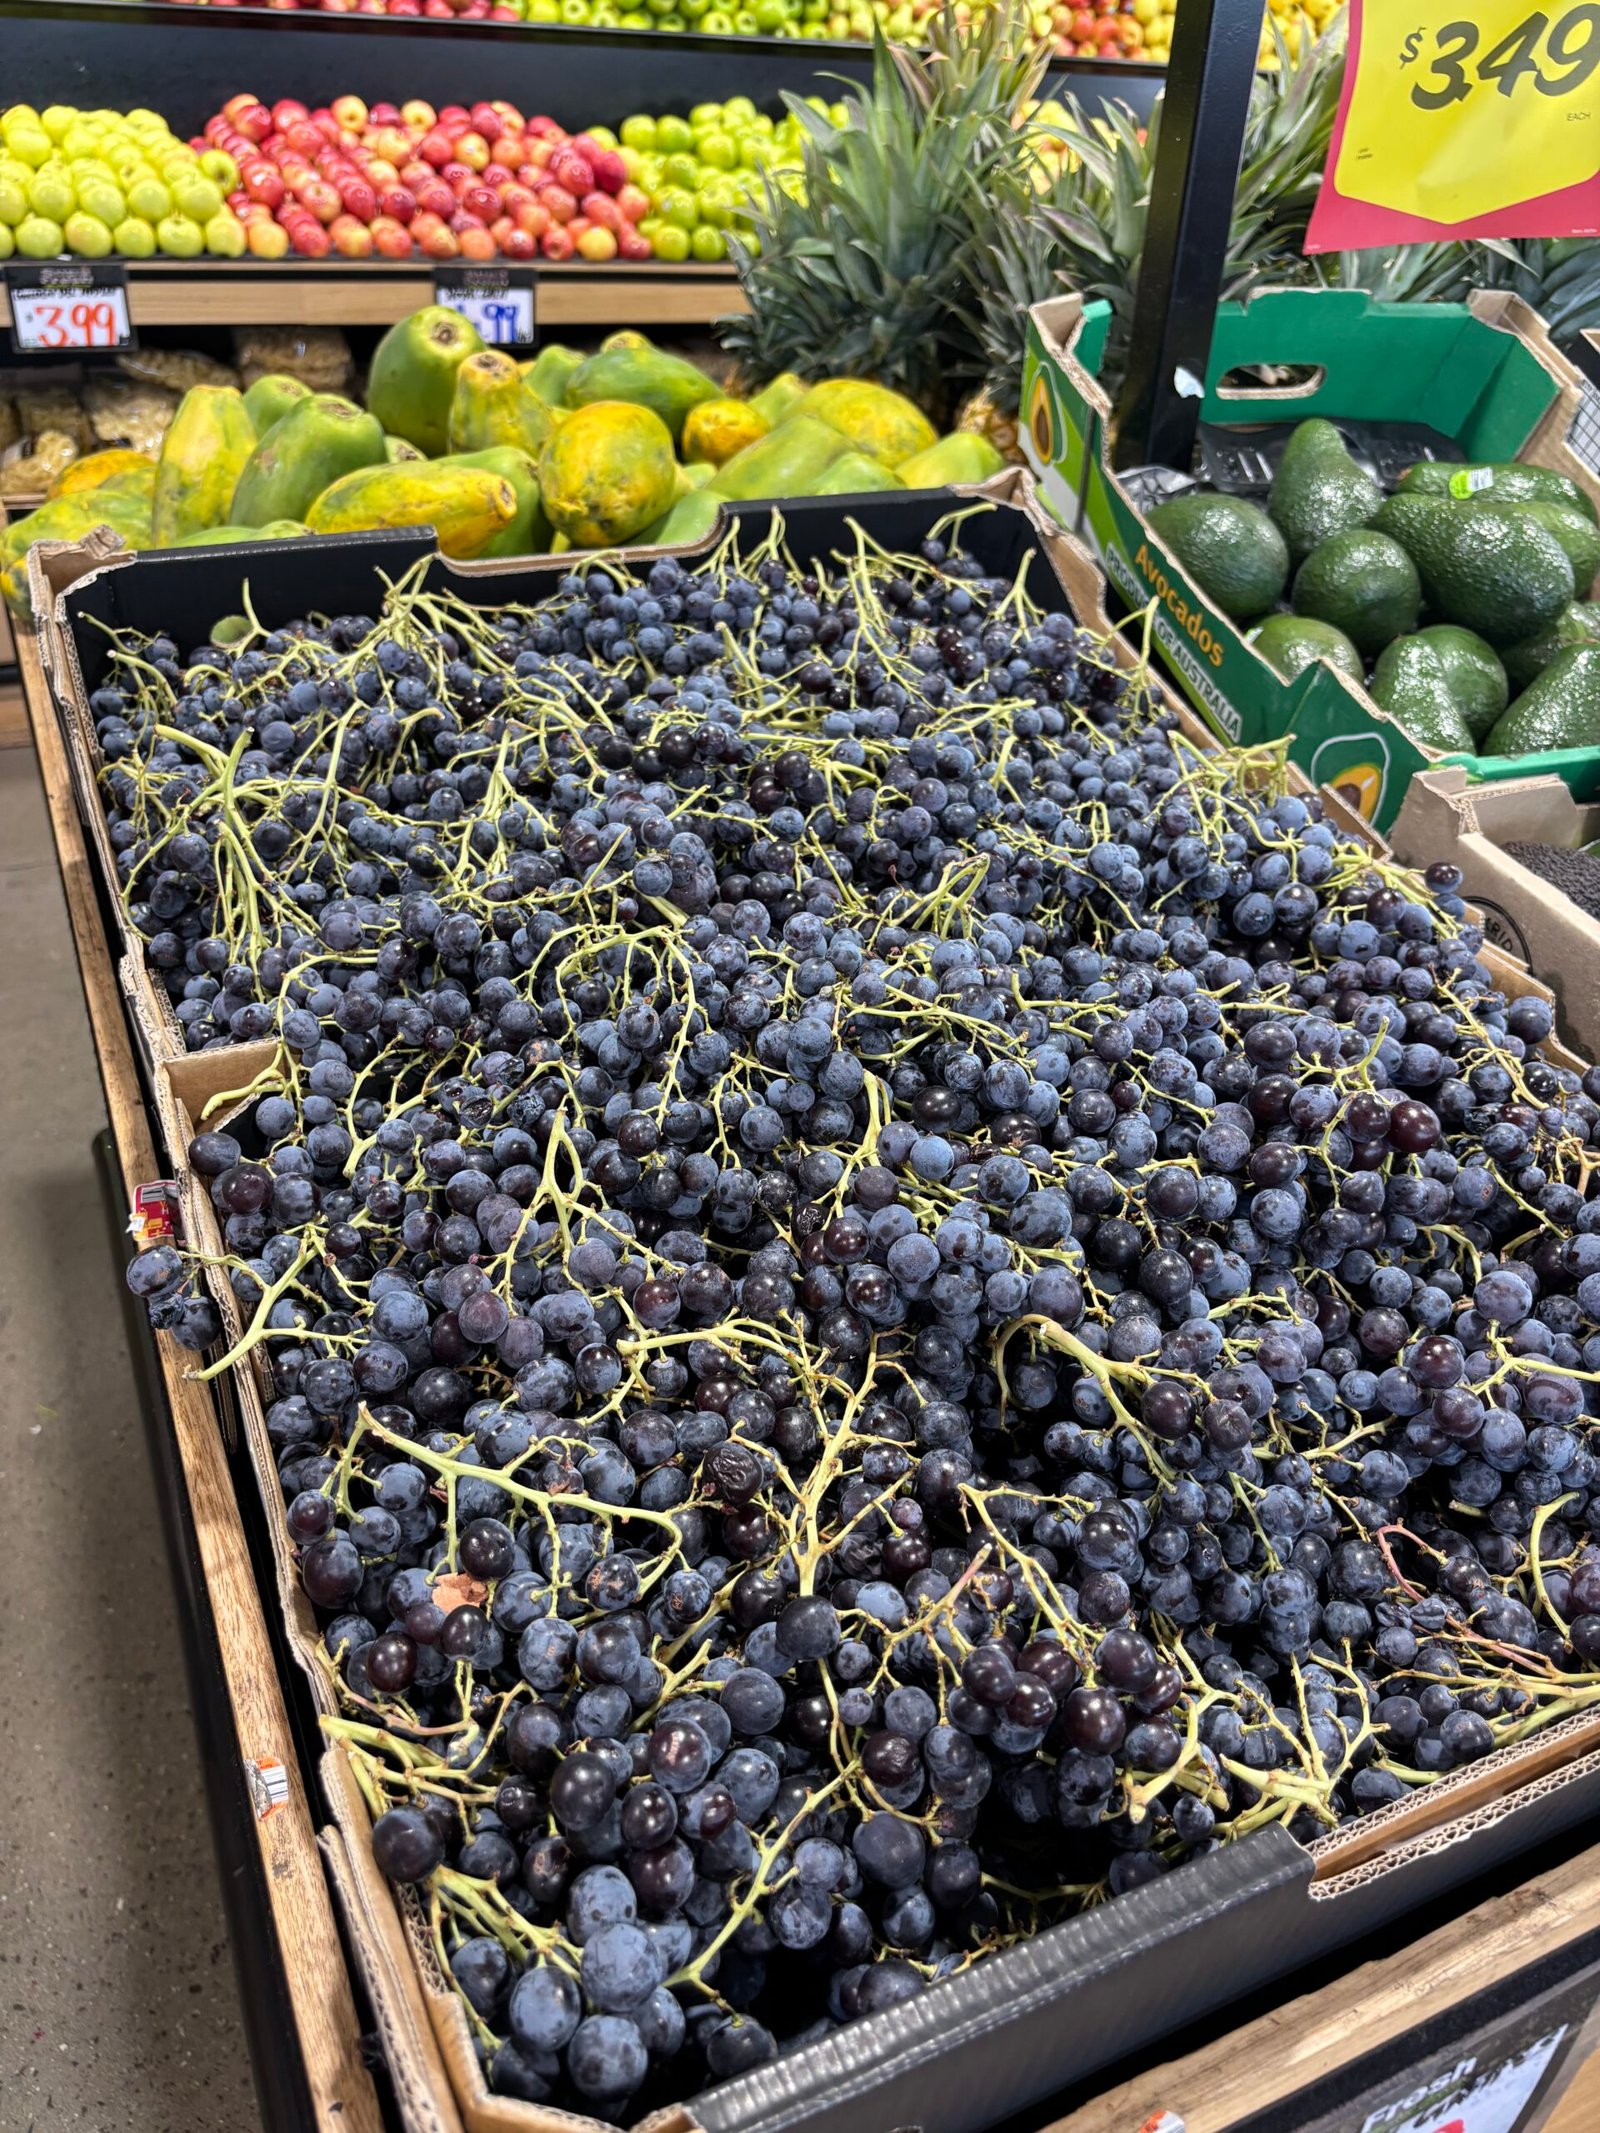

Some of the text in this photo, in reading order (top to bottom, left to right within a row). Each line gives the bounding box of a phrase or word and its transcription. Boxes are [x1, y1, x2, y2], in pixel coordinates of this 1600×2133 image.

[1135, 544, 1225, 667] Avocados
[1157, 620, 1174, 646] OF
[1172, 645, 1240, 739] AUSTRALIA
[1361, 2056, 1478, 2133] Fresh
